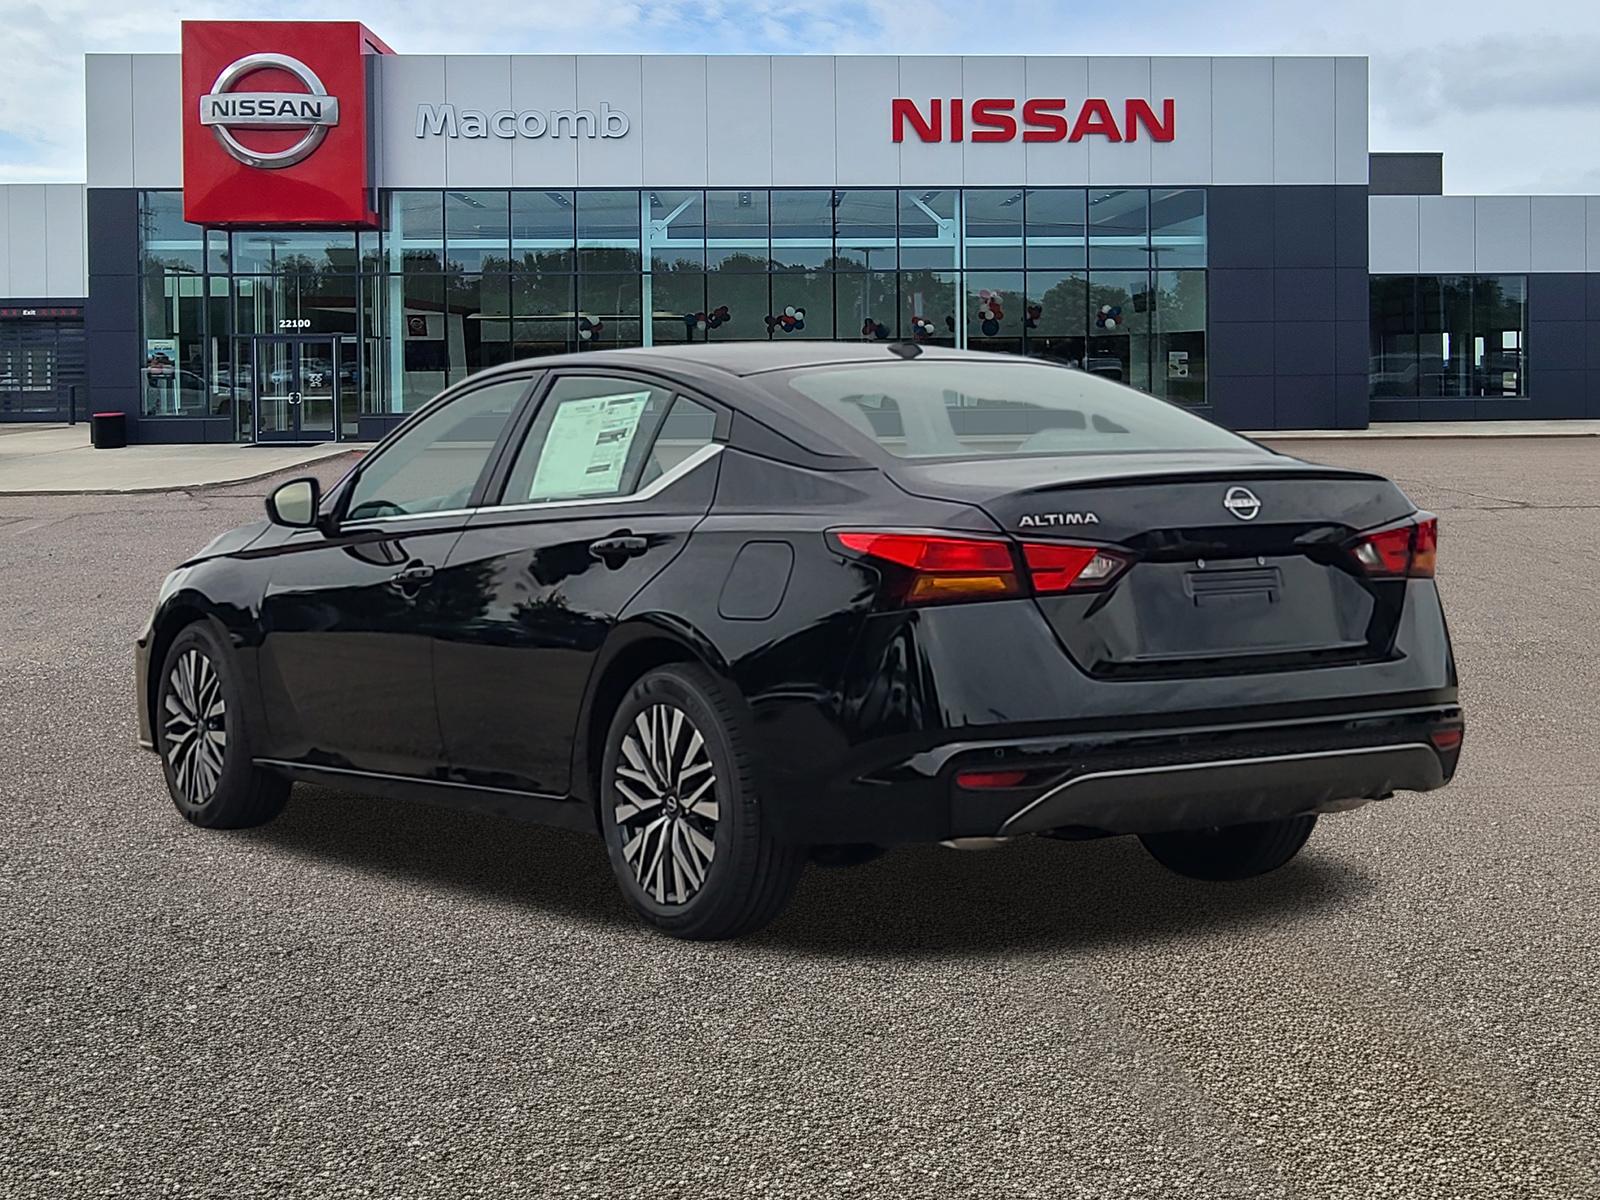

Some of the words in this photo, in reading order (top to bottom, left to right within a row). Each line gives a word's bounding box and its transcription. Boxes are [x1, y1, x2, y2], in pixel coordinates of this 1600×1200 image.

[211, 100, 322, 118] NISSAN
[415, 102, 630, 139] Macomb
[892, 98, 1176, 143] NISSAN
[279, 319, 311, 328] 22100
[1018, 512, 1100, 528] ALTIMA
